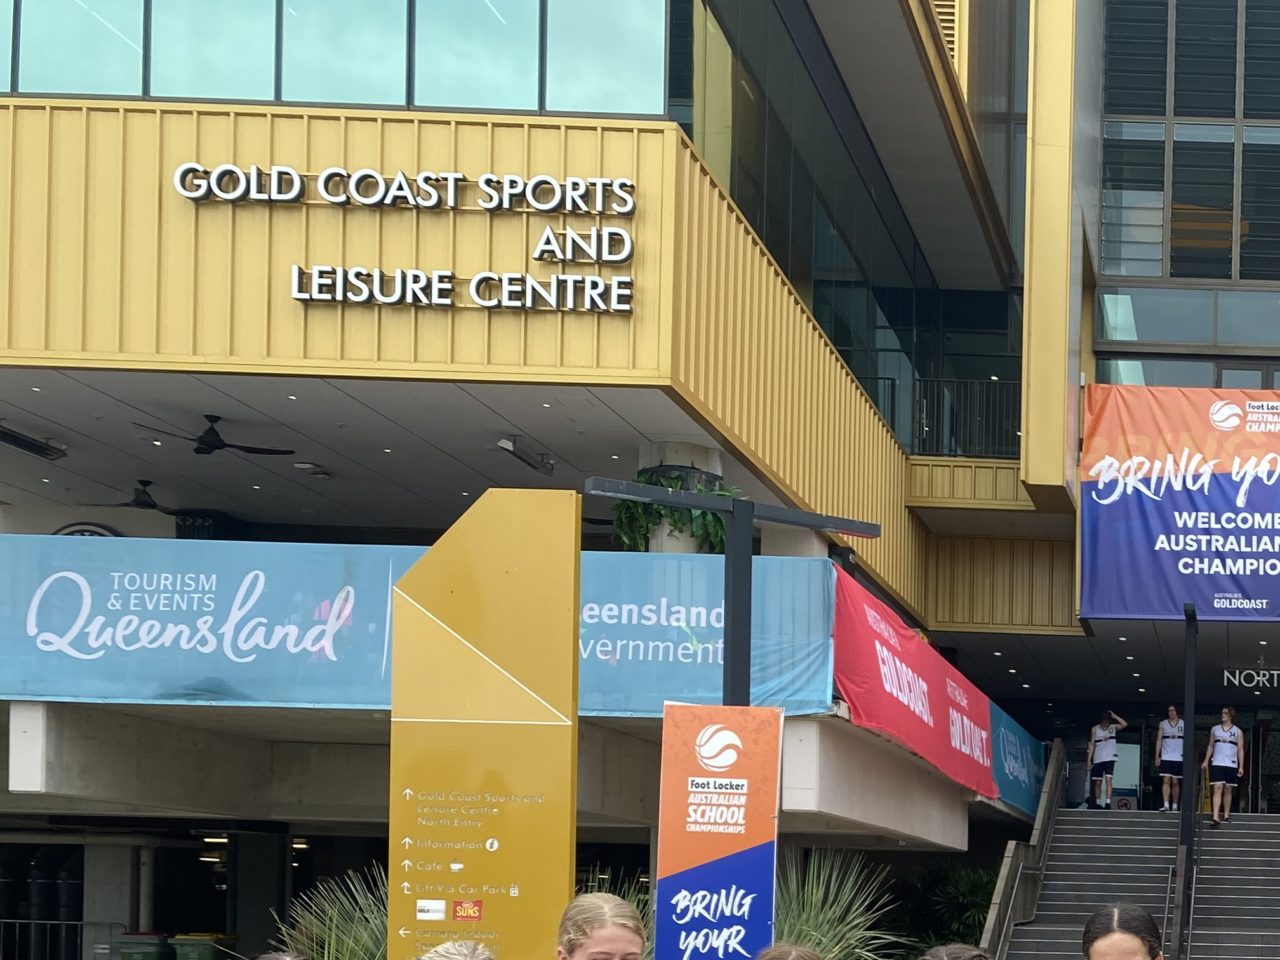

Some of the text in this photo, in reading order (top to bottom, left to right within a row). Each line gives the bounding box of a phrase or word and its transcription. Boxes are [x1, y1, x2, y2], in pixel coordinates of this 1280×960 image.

[173, 162, 635, 214] GOLD COAST SPORTS
[532, 225, 633, 262] AND
[291, 264, 632, 311] LEISURE CENTRE
[1248, 403, 1264, 411] Foot
[1088, 447, 1222, 505] BRING
[110, 572, 217, 592] TOURISM
[107, 593, 215, 611] & EVENTS
[26, 569, 355, 663] Queensland
[579, 597, 725, 628] eensland
[579, 638, 725, 665] vernment
[690, 779, 745, 791] Foot Locker
[687, 793, 747, 806] AUSTRALIAN
[461, 805, 499, 815] Centre
[686, 805, 746, 824] SCHOOL
[686, 823, 746, 834] CHAMPIONSHIPS
[416, 839, 483, 849] Information
[416, 861, 443, 871] Cafe
[416, 884, 433, 893] Lift
[458, 884, 478, 893] Car
[483, 884, 506, 894] Park
[456, 905, 480, 917] SUNS
[670, 885, 758, 924] BRING
